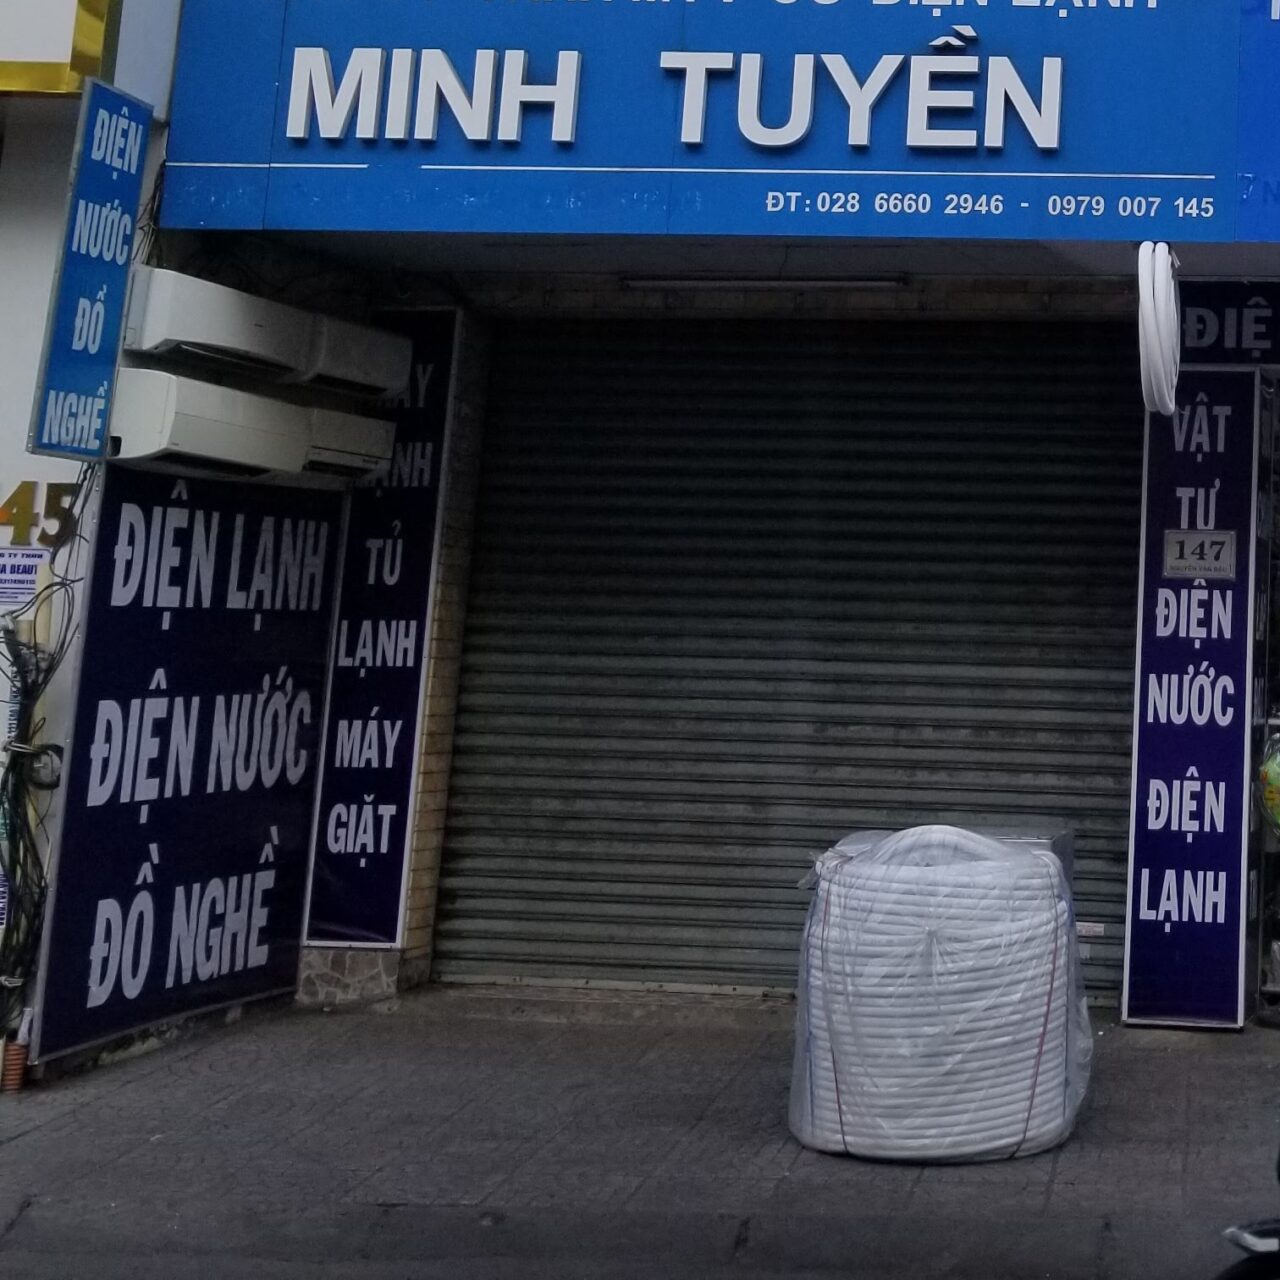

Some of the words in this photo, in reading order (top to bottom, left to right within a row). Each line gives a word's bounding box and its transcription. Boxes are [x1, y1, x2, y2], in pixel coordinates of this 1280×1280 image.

[286, 46, 582, 144] MINH
[658, 24, 1064, 151] TUYỀN
[90, 106, 144, 181] ĐIỆN
[71, 198, 133, 267] NƯỚC
[874, 192, 932, 215] 6660
[943, 192, 1005, 216] 2946
[1047, 194, 1106, 217] 0979
[1117, 196, 1161, 217] 007
[1173, 196, 1215, 219] 145
[1172, 391, 1232, 463] VẬT
[1176, 477, 1221, 530] TƯ
[110, 479, 221, 631] ĐIỆN
[226, 513, 329, 631] LẠNH
[365, 520, 404, 586] TỦ
[1174, 540, 1227, 562] 147
[337, 619, 418, 678] LẠNH
[1155, 578, 1233, 649] ĐIỆN
[1147, 661, 1235, 727] NƯỚC
[86, 668, 201, 824] ĐIỆN
[206, 665, 312, 794] NƯỚC
[334, 706, 403, 769] MÁY
[326, 793, 397, 868] GIẶT
[1147, 765, 1226, 844] ĐIỆN
[86, 843, 159, 1009] ĐỒ
[165, 825, 280, 989] NGHỀ
[1139, 868, 1227, 933] LẠNH
